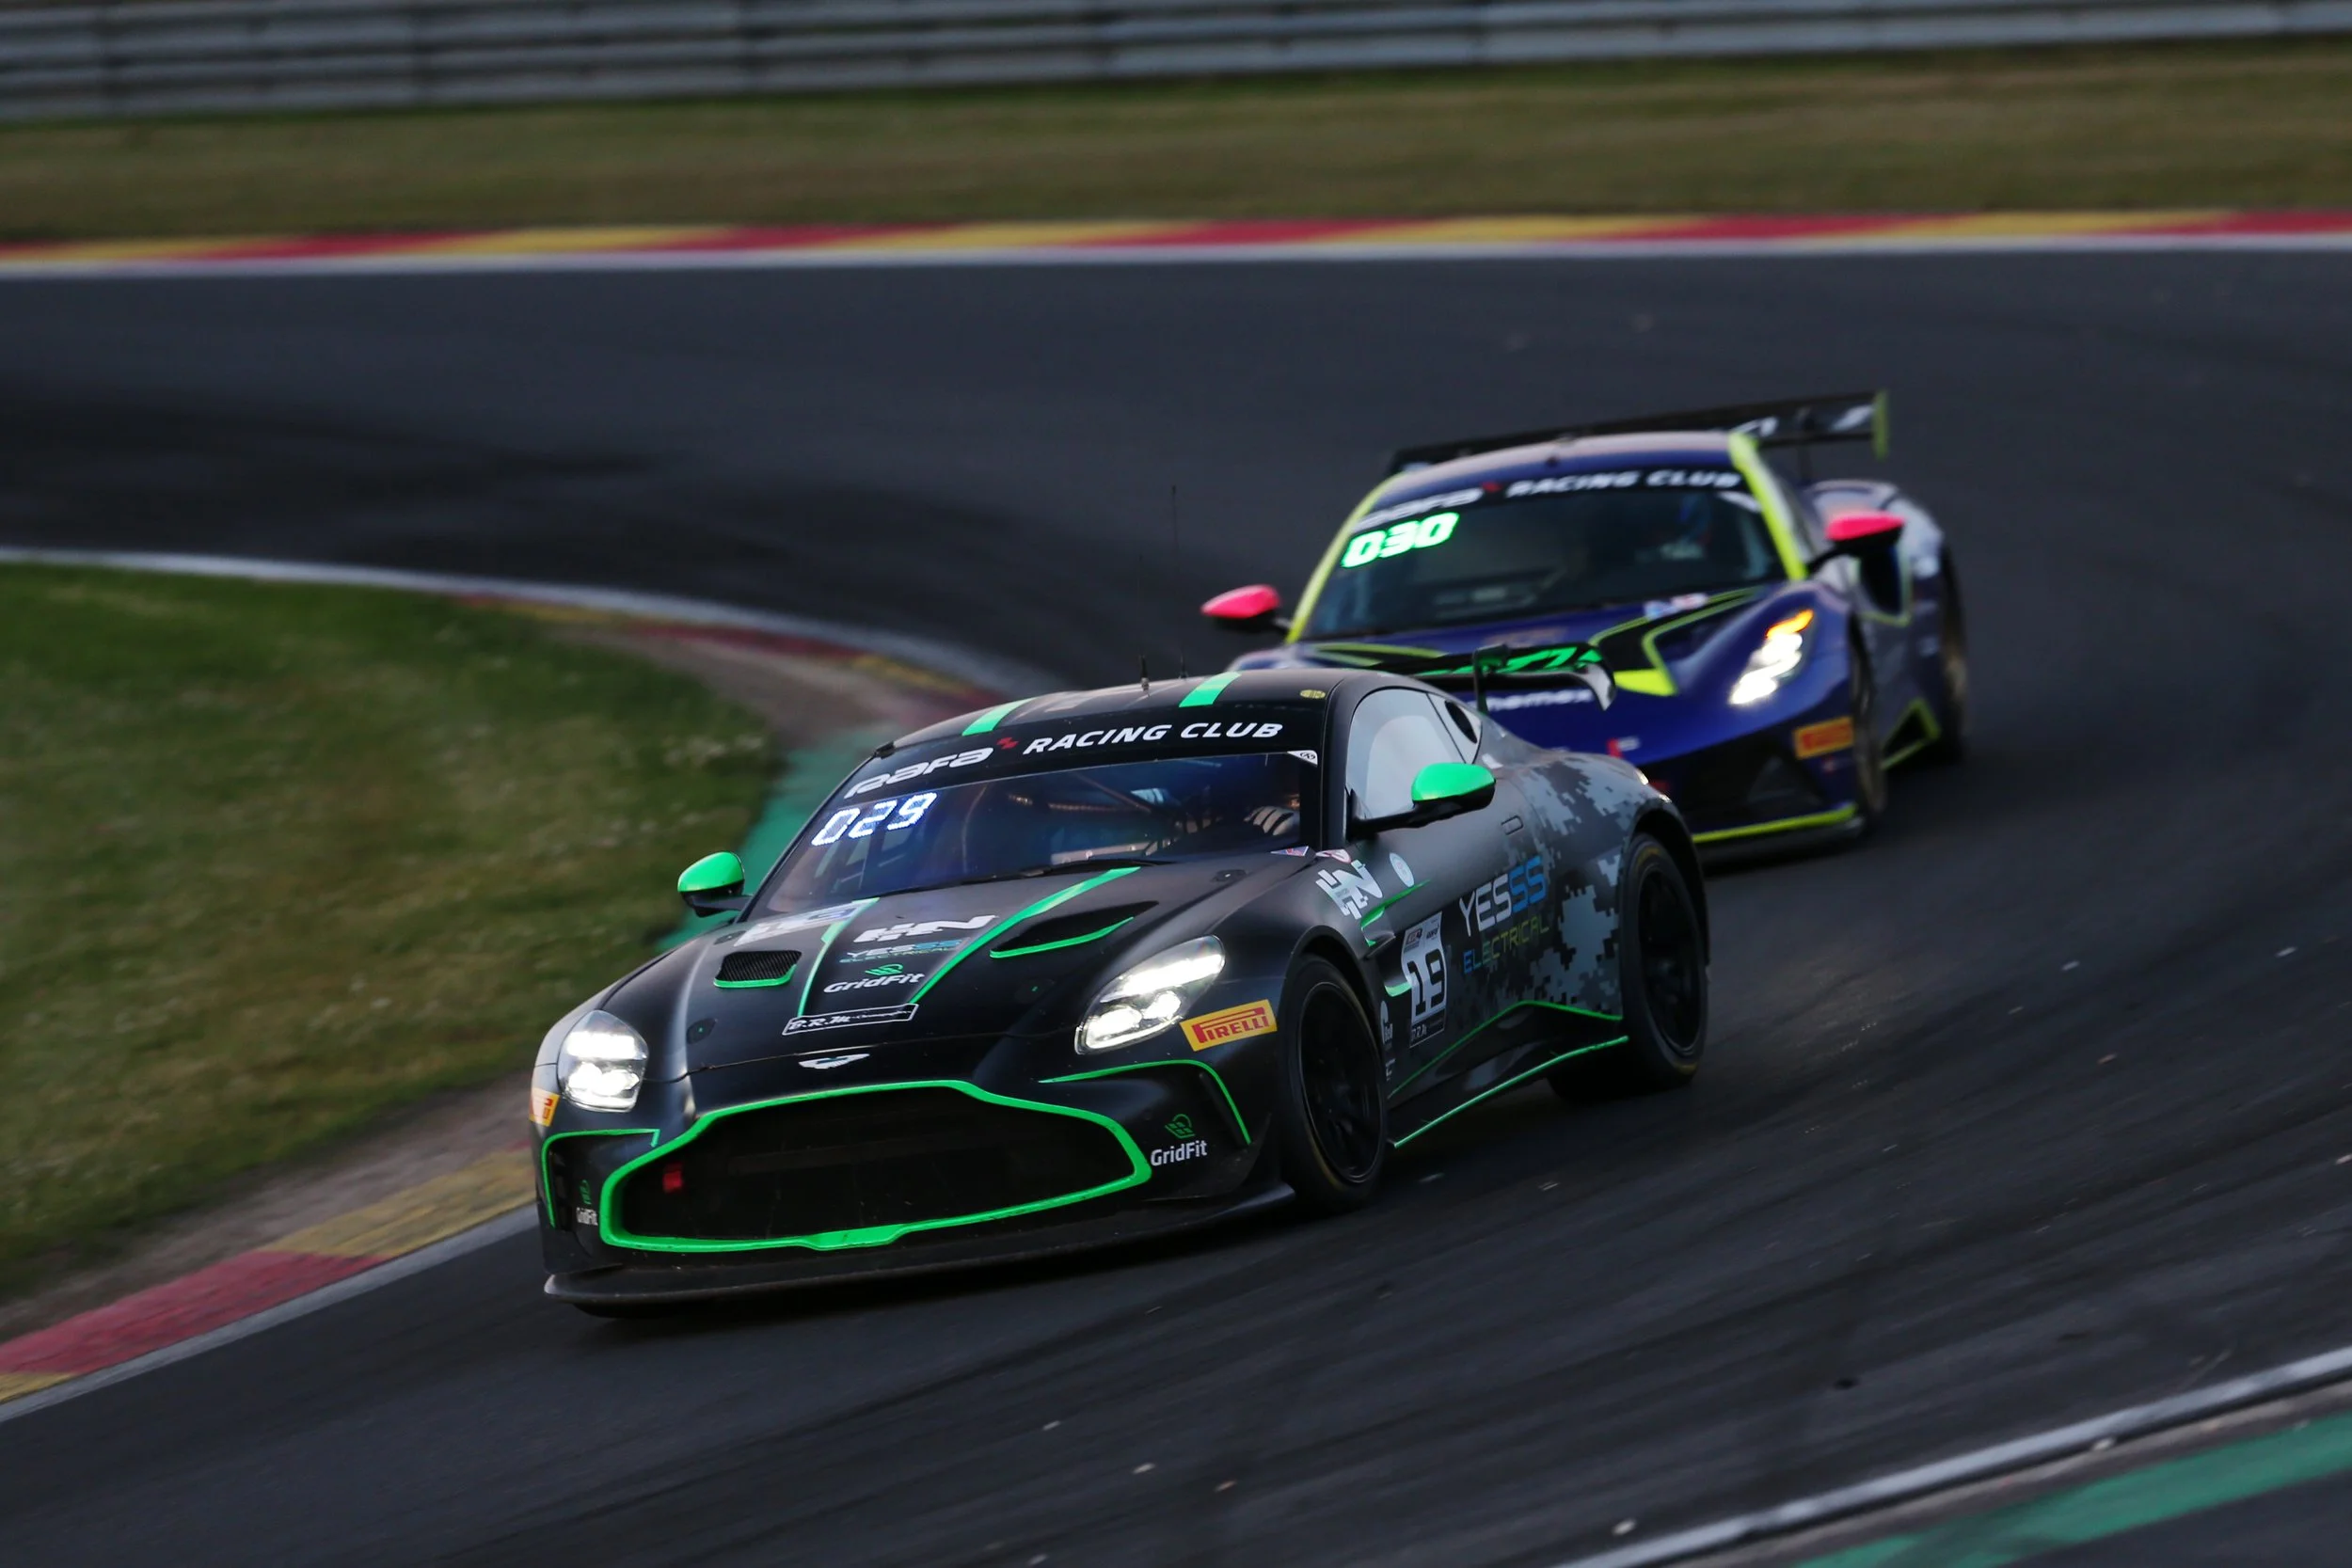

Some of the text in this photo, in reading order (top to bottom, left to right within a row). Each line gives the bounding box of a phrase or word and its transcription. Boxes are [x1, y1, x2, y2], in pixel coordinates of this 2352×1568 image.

[1646, 469, 1741, 488] CLUB
[1341, 512, 1459, 568] 030
[1023, 724, 1172, 755] RACING
[1180, 721, 1283, 739] CLUB
[811, 791, 938, 847] 029
[1458, 854, 1548, 938] YESSS
[1463, 914, 1550, 974] ELECTRICAL
[823, 972, 926, 993] GridFit
[1406, 948, 1446, 1017] 19
[1192, 1006, 1270, 1044] PIRELLI
[1151, 1139, 1208, 1166] GridFit
